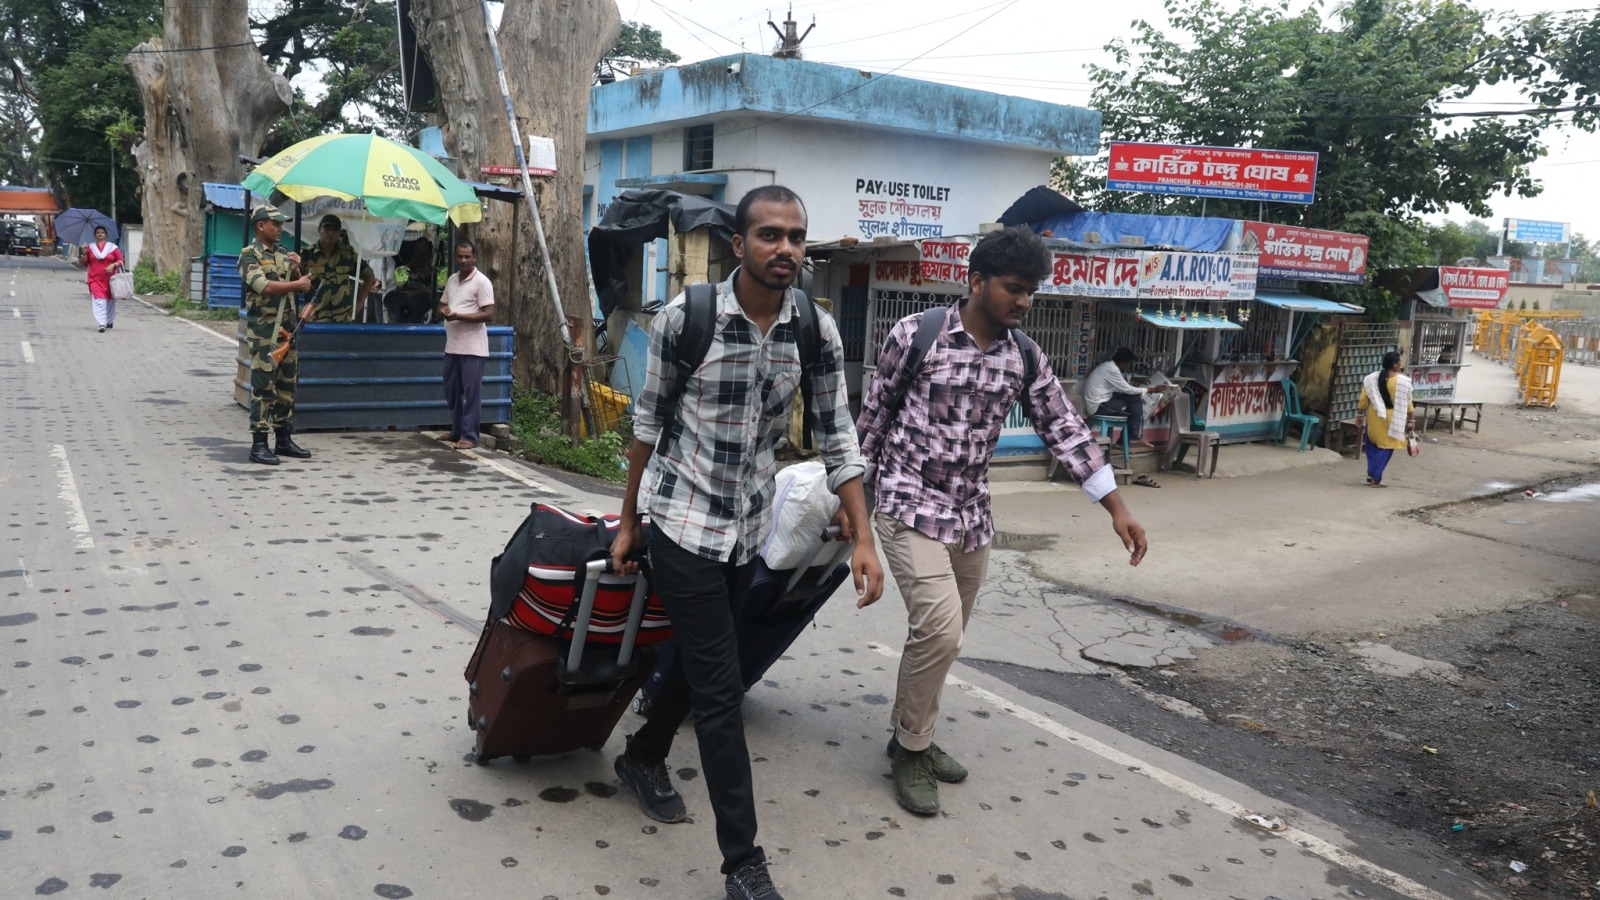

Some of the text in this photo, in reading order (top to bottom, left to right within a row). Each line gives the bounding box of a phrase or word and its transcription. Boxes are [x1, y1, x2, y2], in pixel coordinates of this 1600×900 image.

[382, 174, 418, 185] COSMO
[1244, 164, 1290, 182] ঘোষ
[384, 181, 421, 191] BAZAAR
[856, 178, 950, 202] PAY & USE TOILET
[858, 220, 890, 239] सुलभ
[921, 241, 970, 260] অশোক
[920, 260, 952, 281] কুমার
[954, 264, 969, 285] দে
[1052, 252, 1139, 287] কুমার দে
[1150, 285, 1177, 298] Foreign
[1206, 286, 1229, 299] Changer
[1078, 302, 1090, 375] WELCOME
